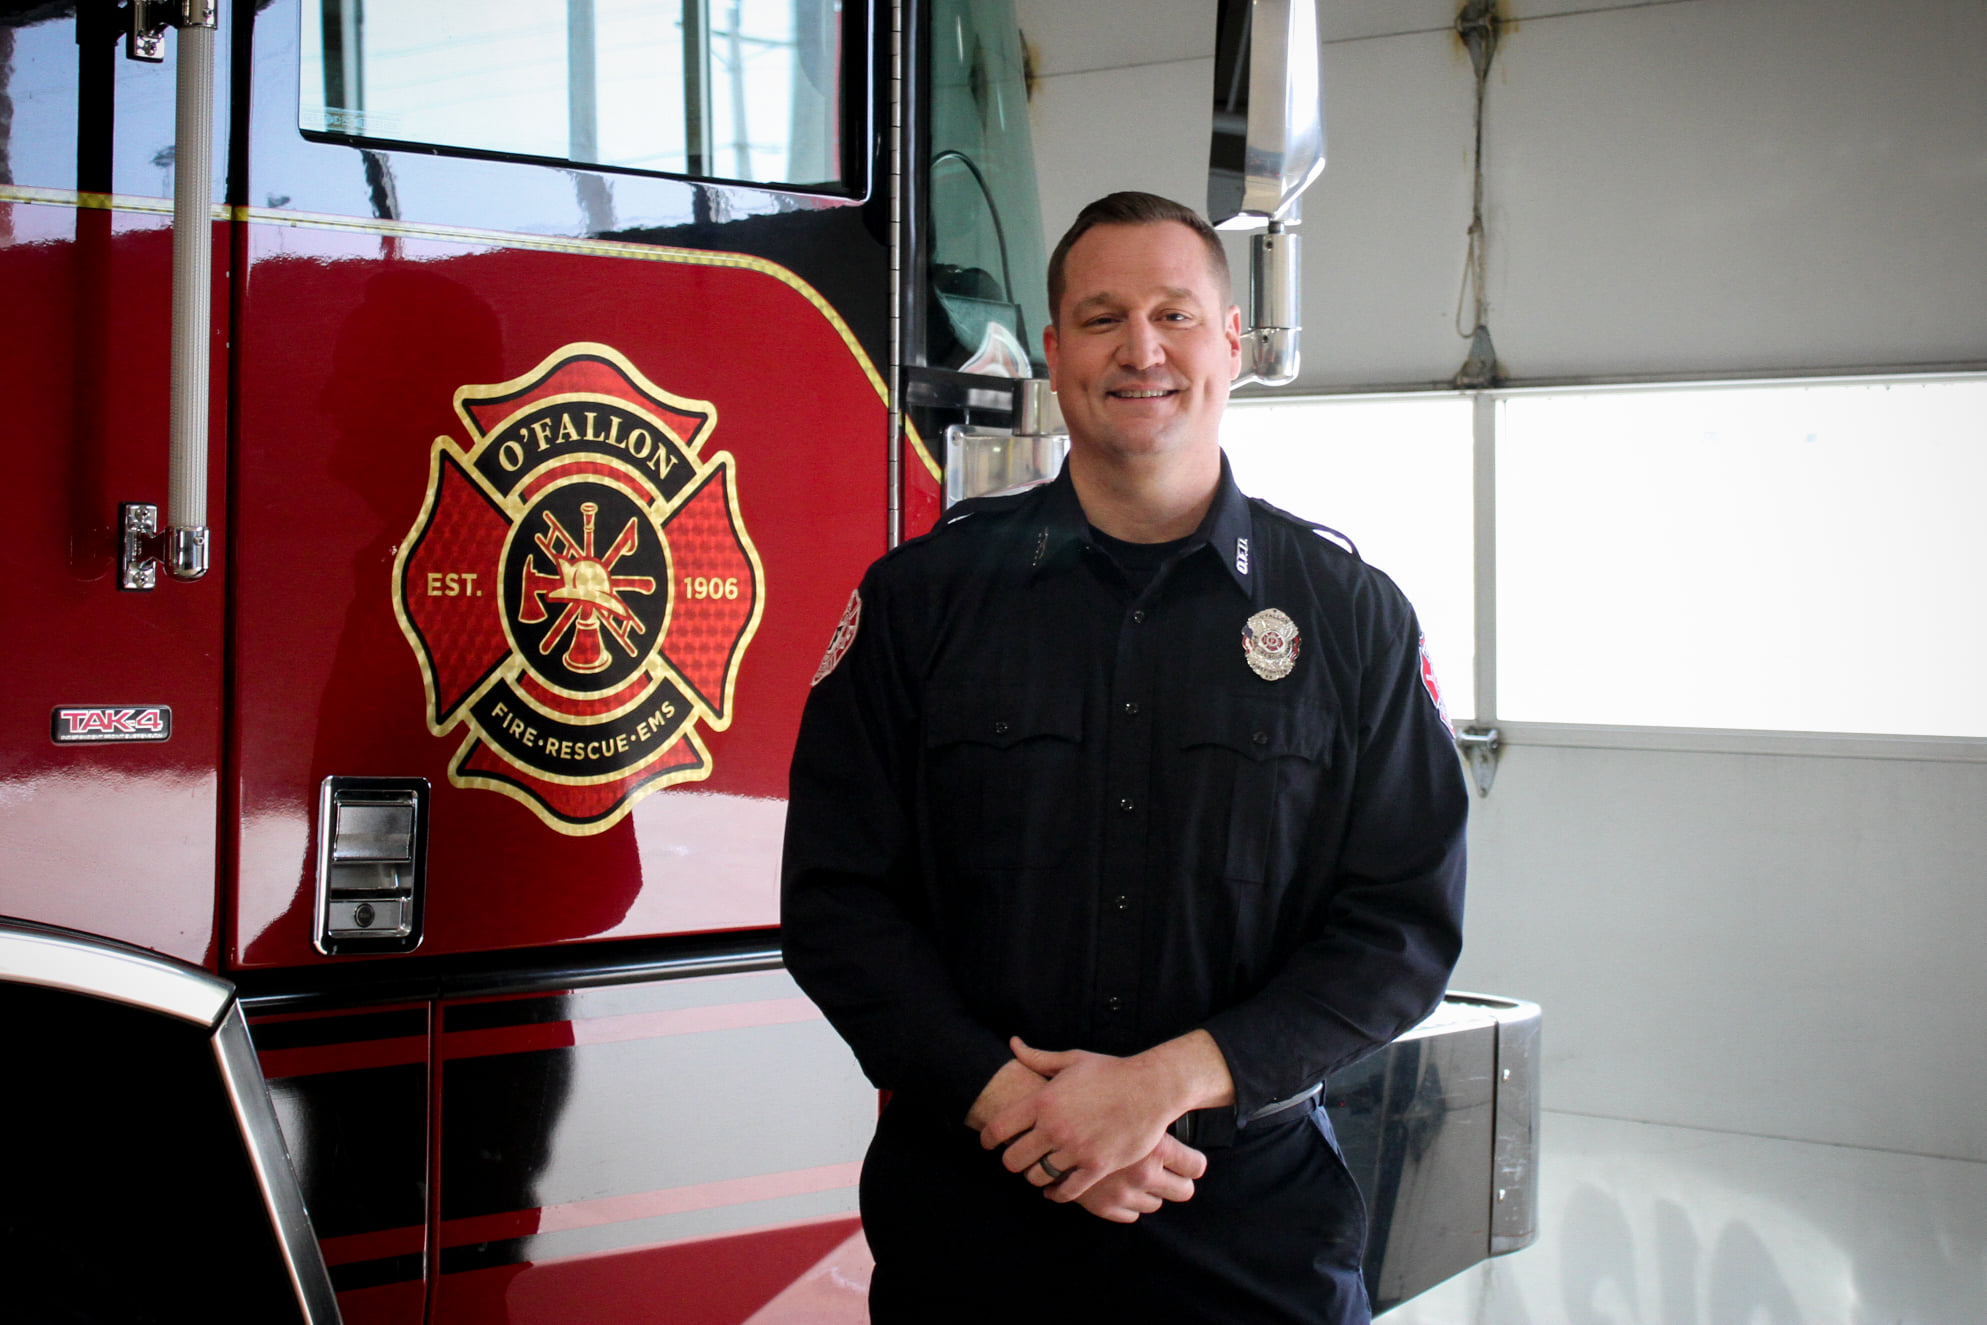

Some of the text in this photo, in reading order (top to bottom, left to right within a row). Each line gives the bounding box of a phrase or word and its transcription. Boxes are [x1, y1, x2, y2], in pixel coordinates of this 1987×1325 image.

[498, 411, 679, 481] O'FALLON
[427, 572, 483, 597] EST.
[683, 576, 739, 600] 1906
[60, 708, 164, 734] TAK-4
